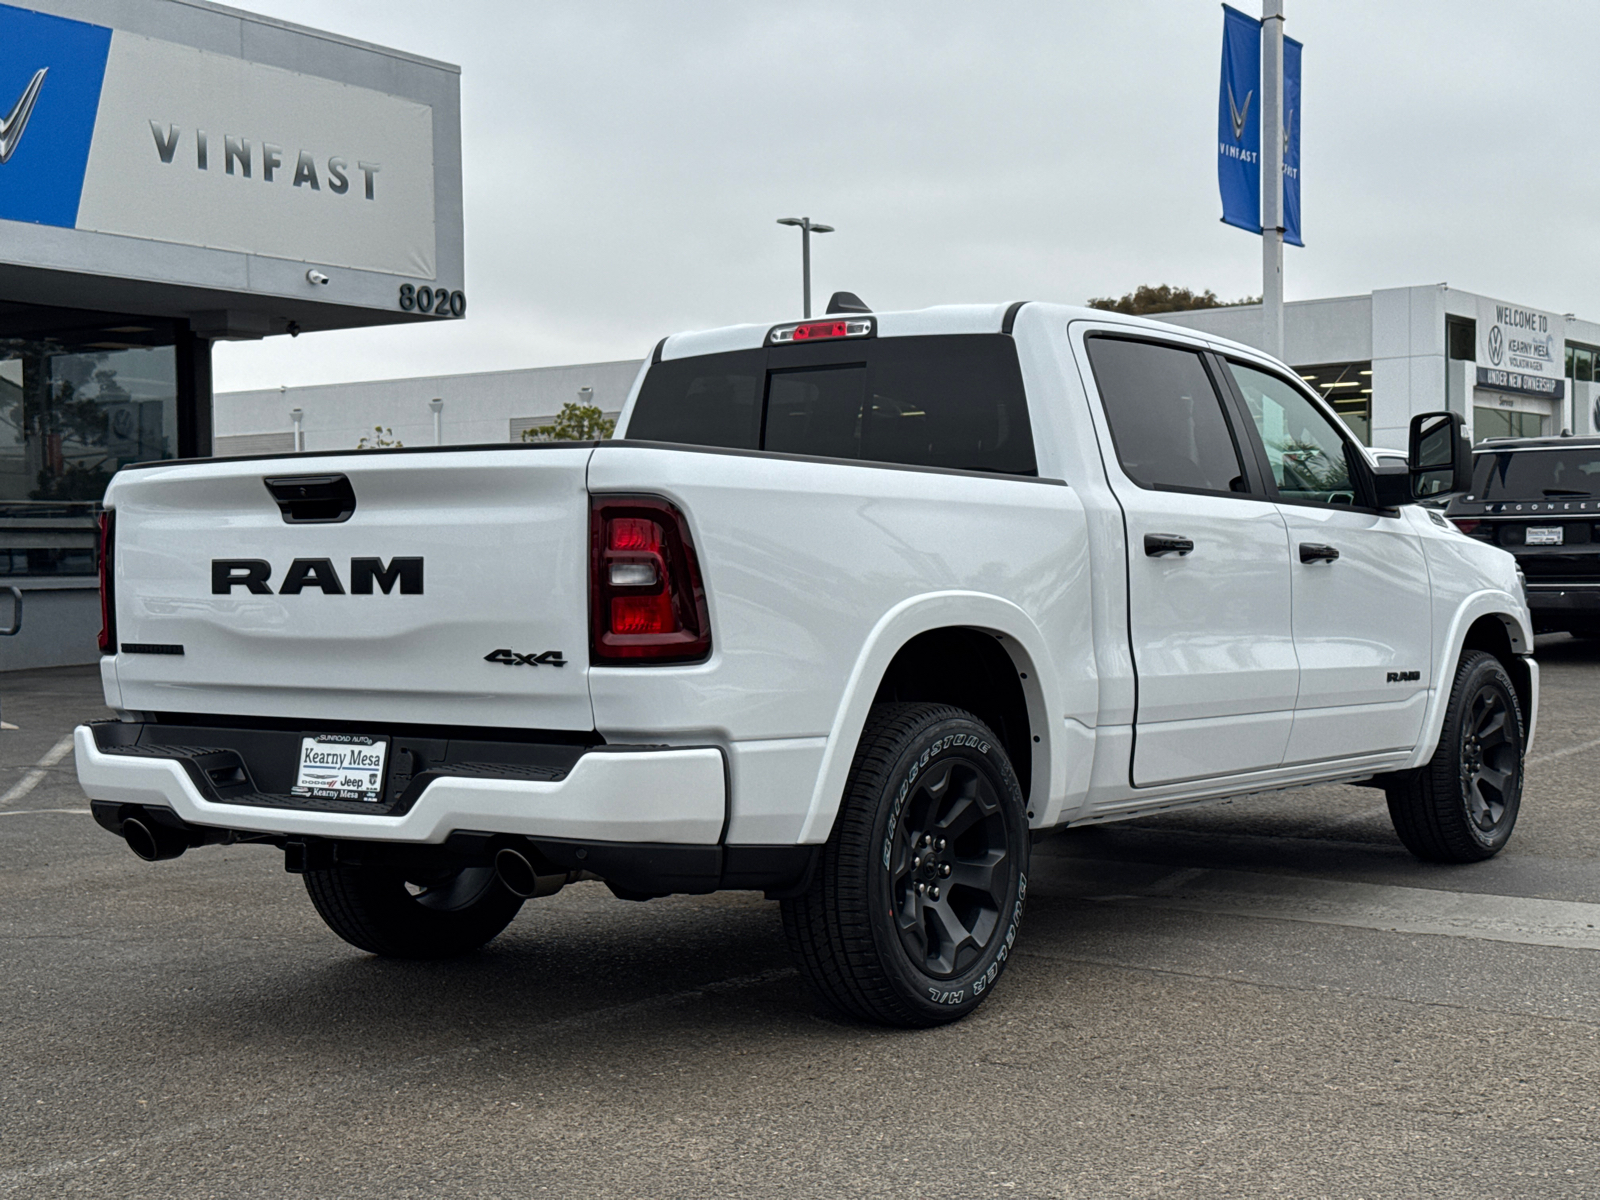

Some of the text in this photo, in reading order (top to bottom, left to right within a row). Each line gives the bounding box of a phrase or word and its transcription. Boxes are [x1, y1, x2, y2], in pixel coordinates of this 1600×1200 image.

[149, 119, 381, 201] VINFAST
[1220, 142, 1257, 164] VINFAST
[1283, 163, 1298, 179] FAST
[400, 283, 467, 317] 8020
[1496, 305, 1548, 333] WELCOME TO
[1508, 339, 1532, 355] KEARNY
[1487, 370, 1556, 393] UNDER NEW OWNERSHIP
[211, 556, 424, 595] RAM
[484, 648, 568, 667] 4x4
[1386, 671, 1421, 683] RAM
[320, 734, 351, 742] SUNROAD
[303, 747, 380, 770] Kearny Mesa
[340, 775, 363, 789] Jeep
[313, 788, 339, 800] Kearny
[340, 789, 359, 799] Mesa
[882, 733, 993, 872] BRIDGESTONE
[928, 872, 1028, 1005] DUELER H/L
